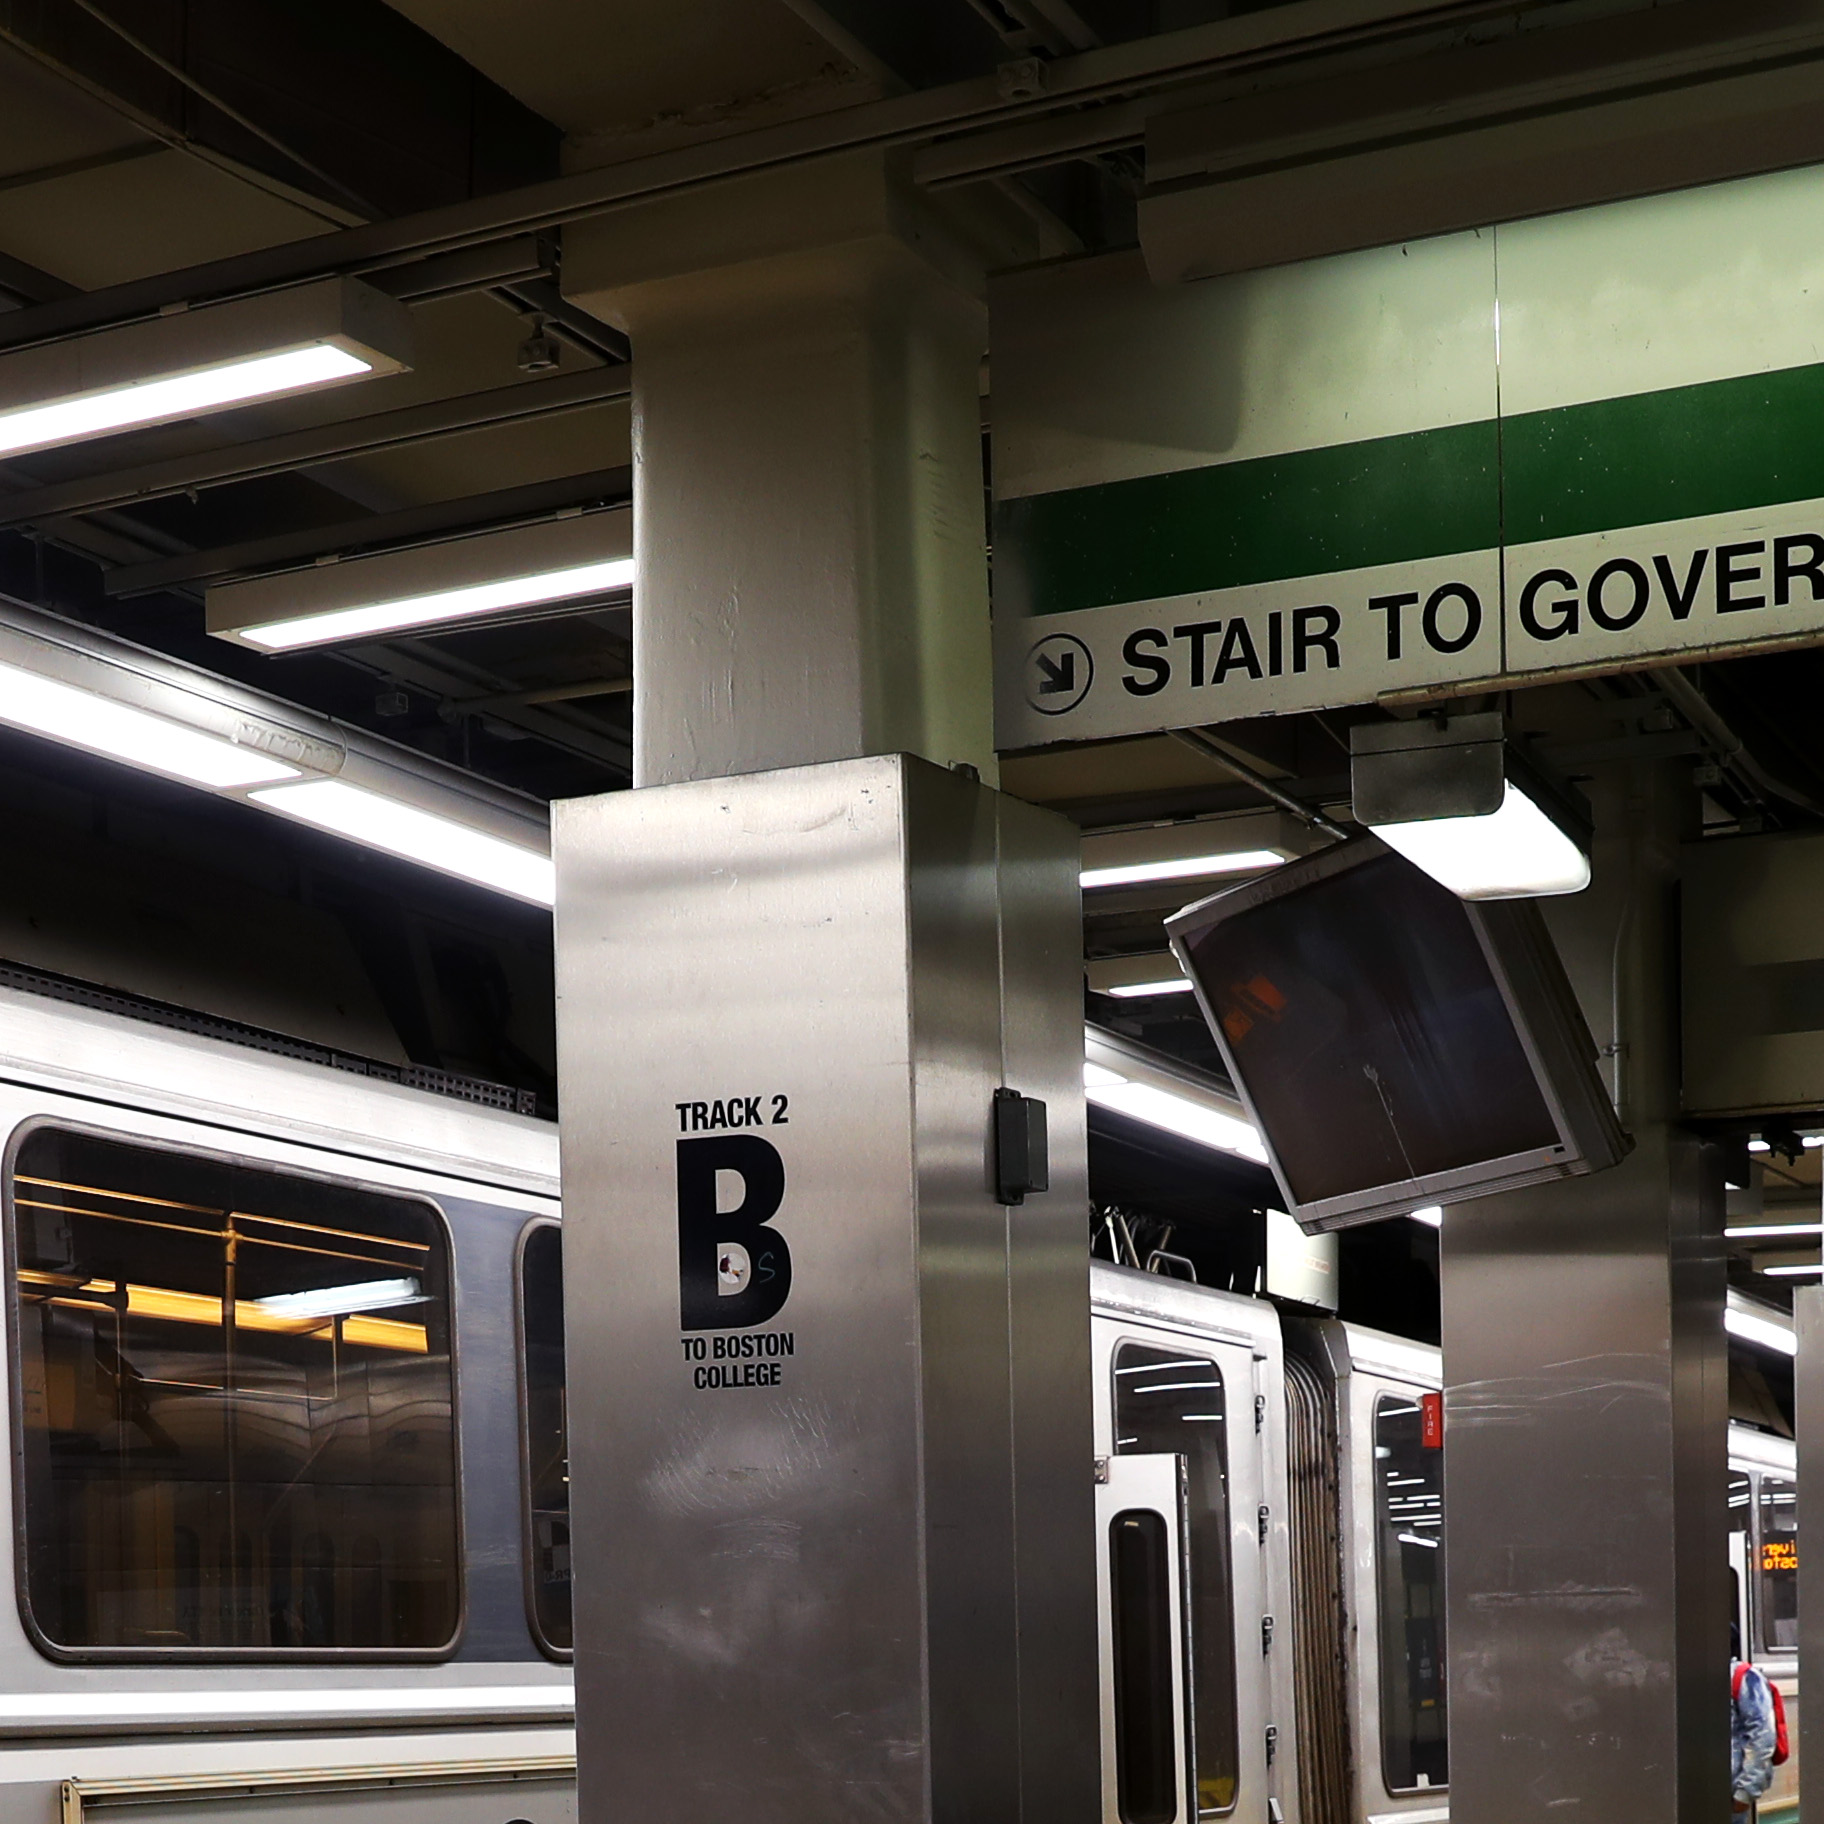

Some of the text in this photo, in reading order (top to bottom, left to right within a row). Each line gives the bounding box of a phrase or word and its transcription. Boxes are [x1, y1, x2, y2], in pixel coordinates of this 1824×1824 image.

[1121, 604, 1342, 697] STAIR
[1368, 582, 1482, 661] TO
[675, 1094, 789, 1132] TRACK 2
[676, 1134, 792, 1331] B
[681, 1332, 795, 1362] TO BOSTON
[694, 1362, 781, 1390] COLLEGE
